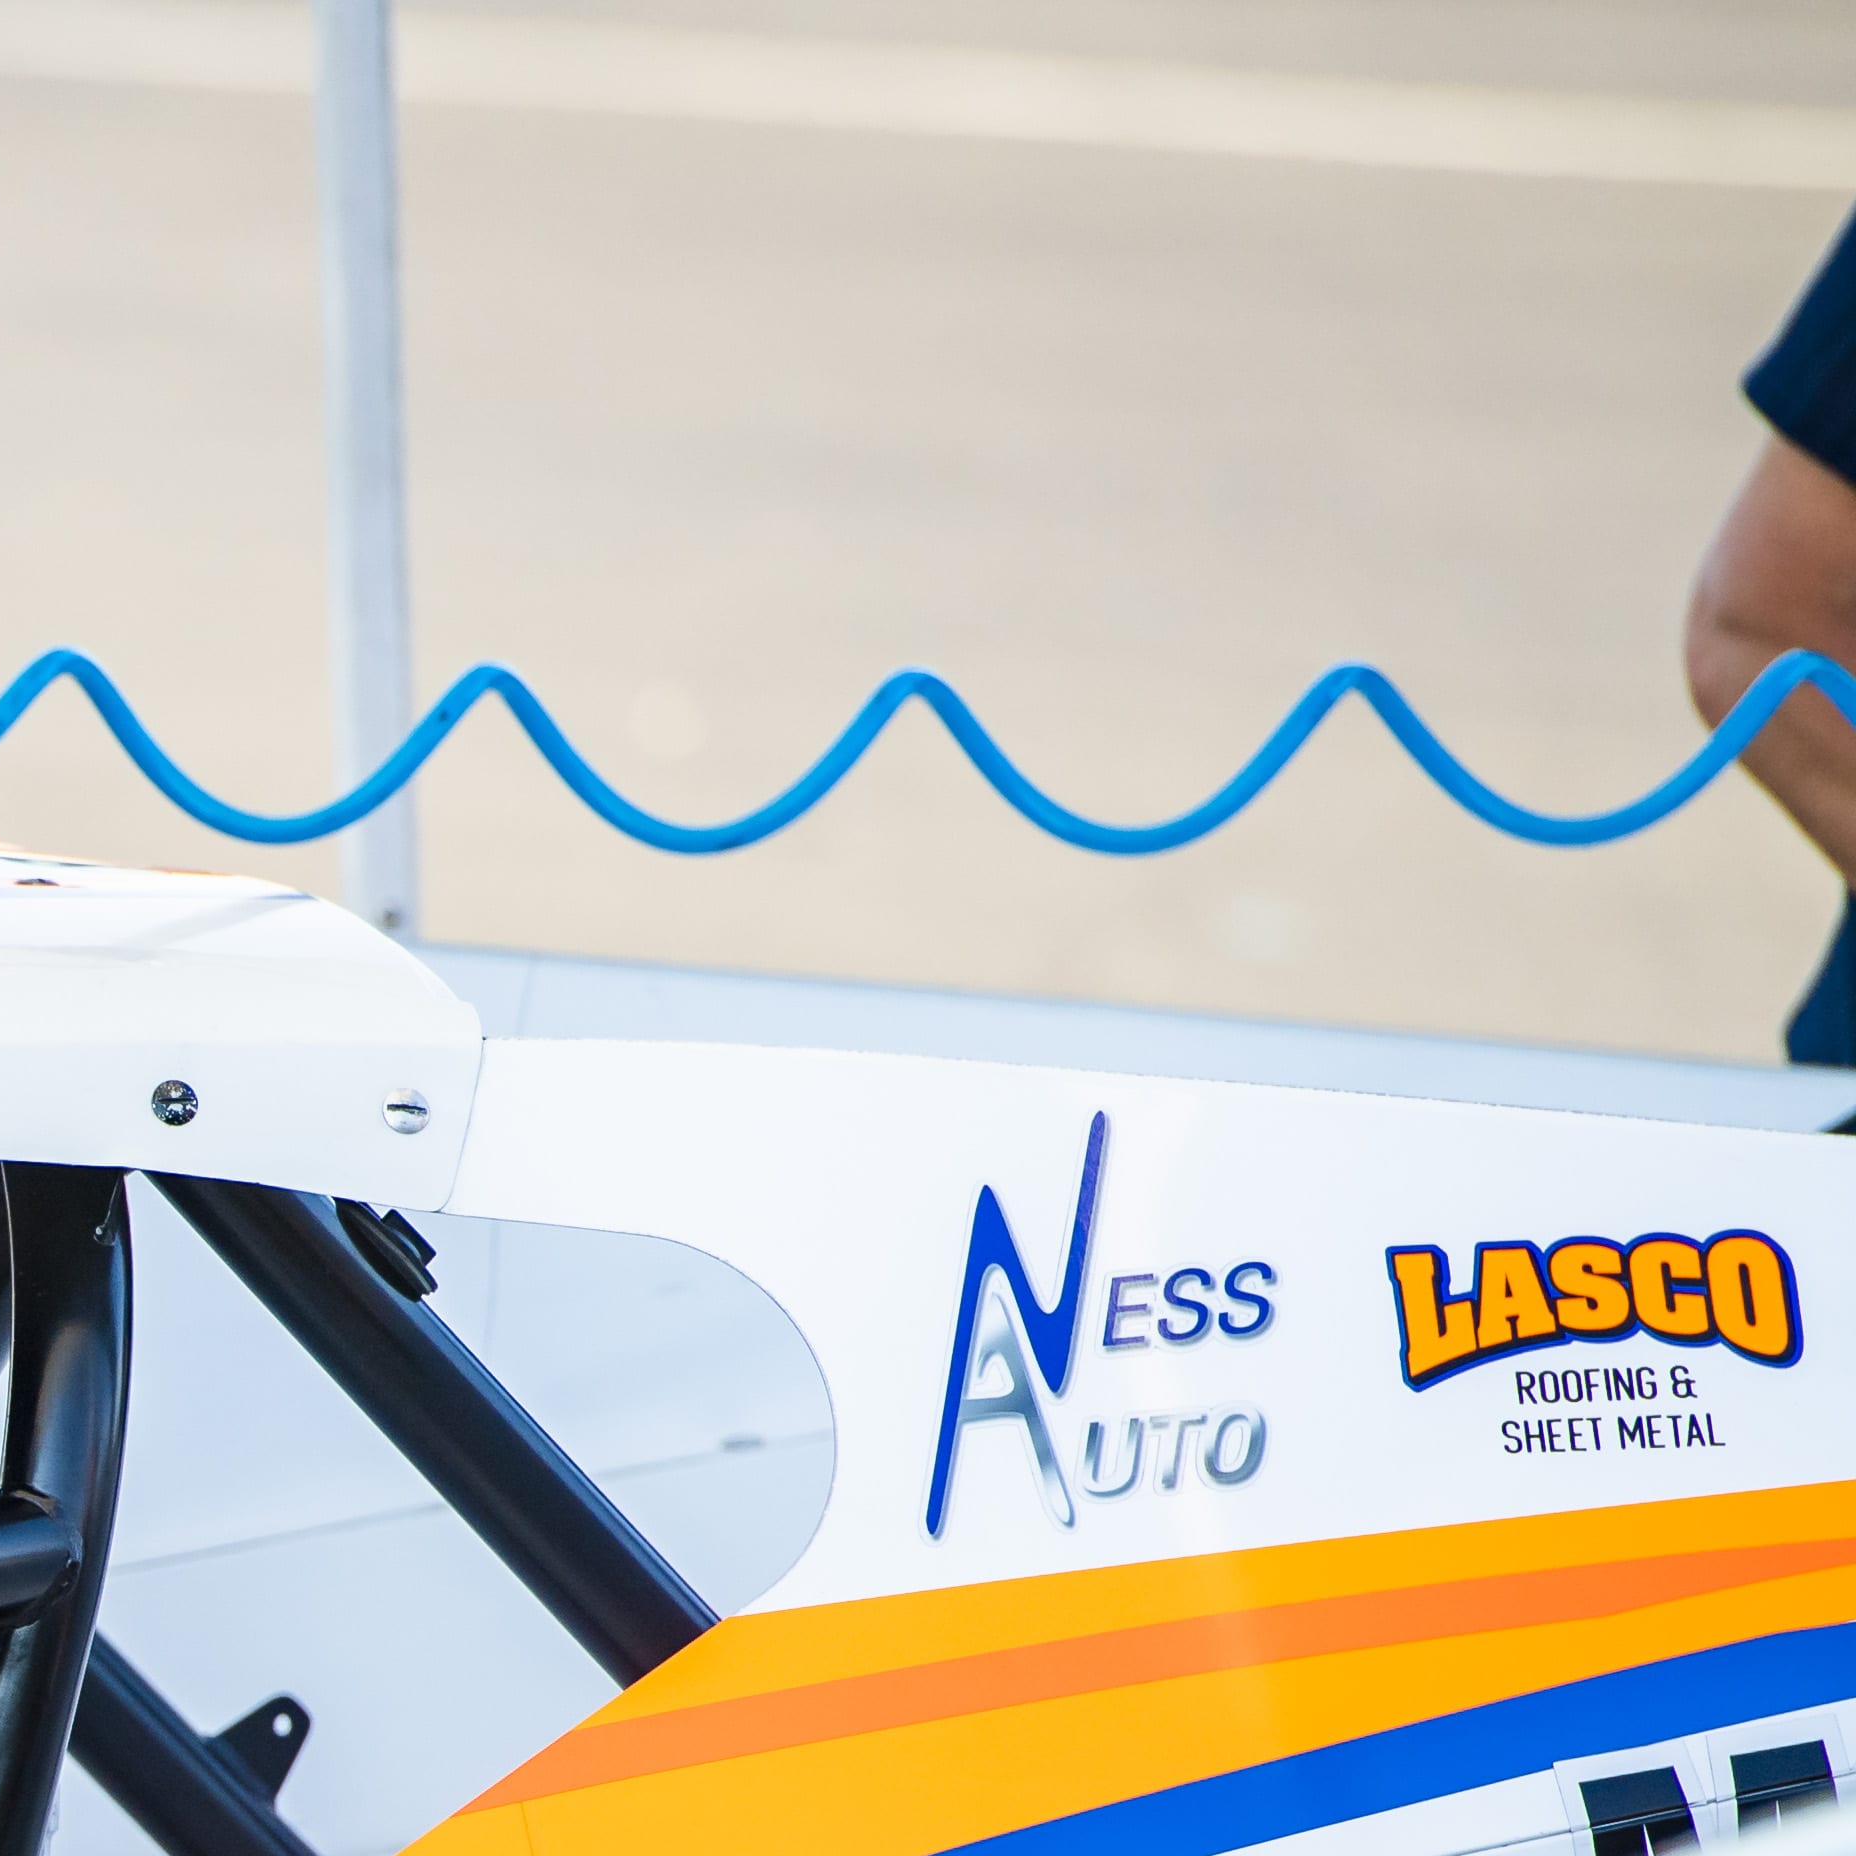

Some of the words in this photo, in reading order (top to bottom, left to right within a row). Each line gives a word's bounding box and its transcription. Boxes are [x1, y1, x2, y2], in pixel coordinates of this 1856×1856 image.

[1385, 1227, 1804, 1392] LASCO
[1514, 1366, 1657, 1406] ROOFING
[1669, 1363, 1698, 1399] &
[1500, 1416, 1603, 1456] SHEET
[1616, 1410, 1727, 1450] METAL
